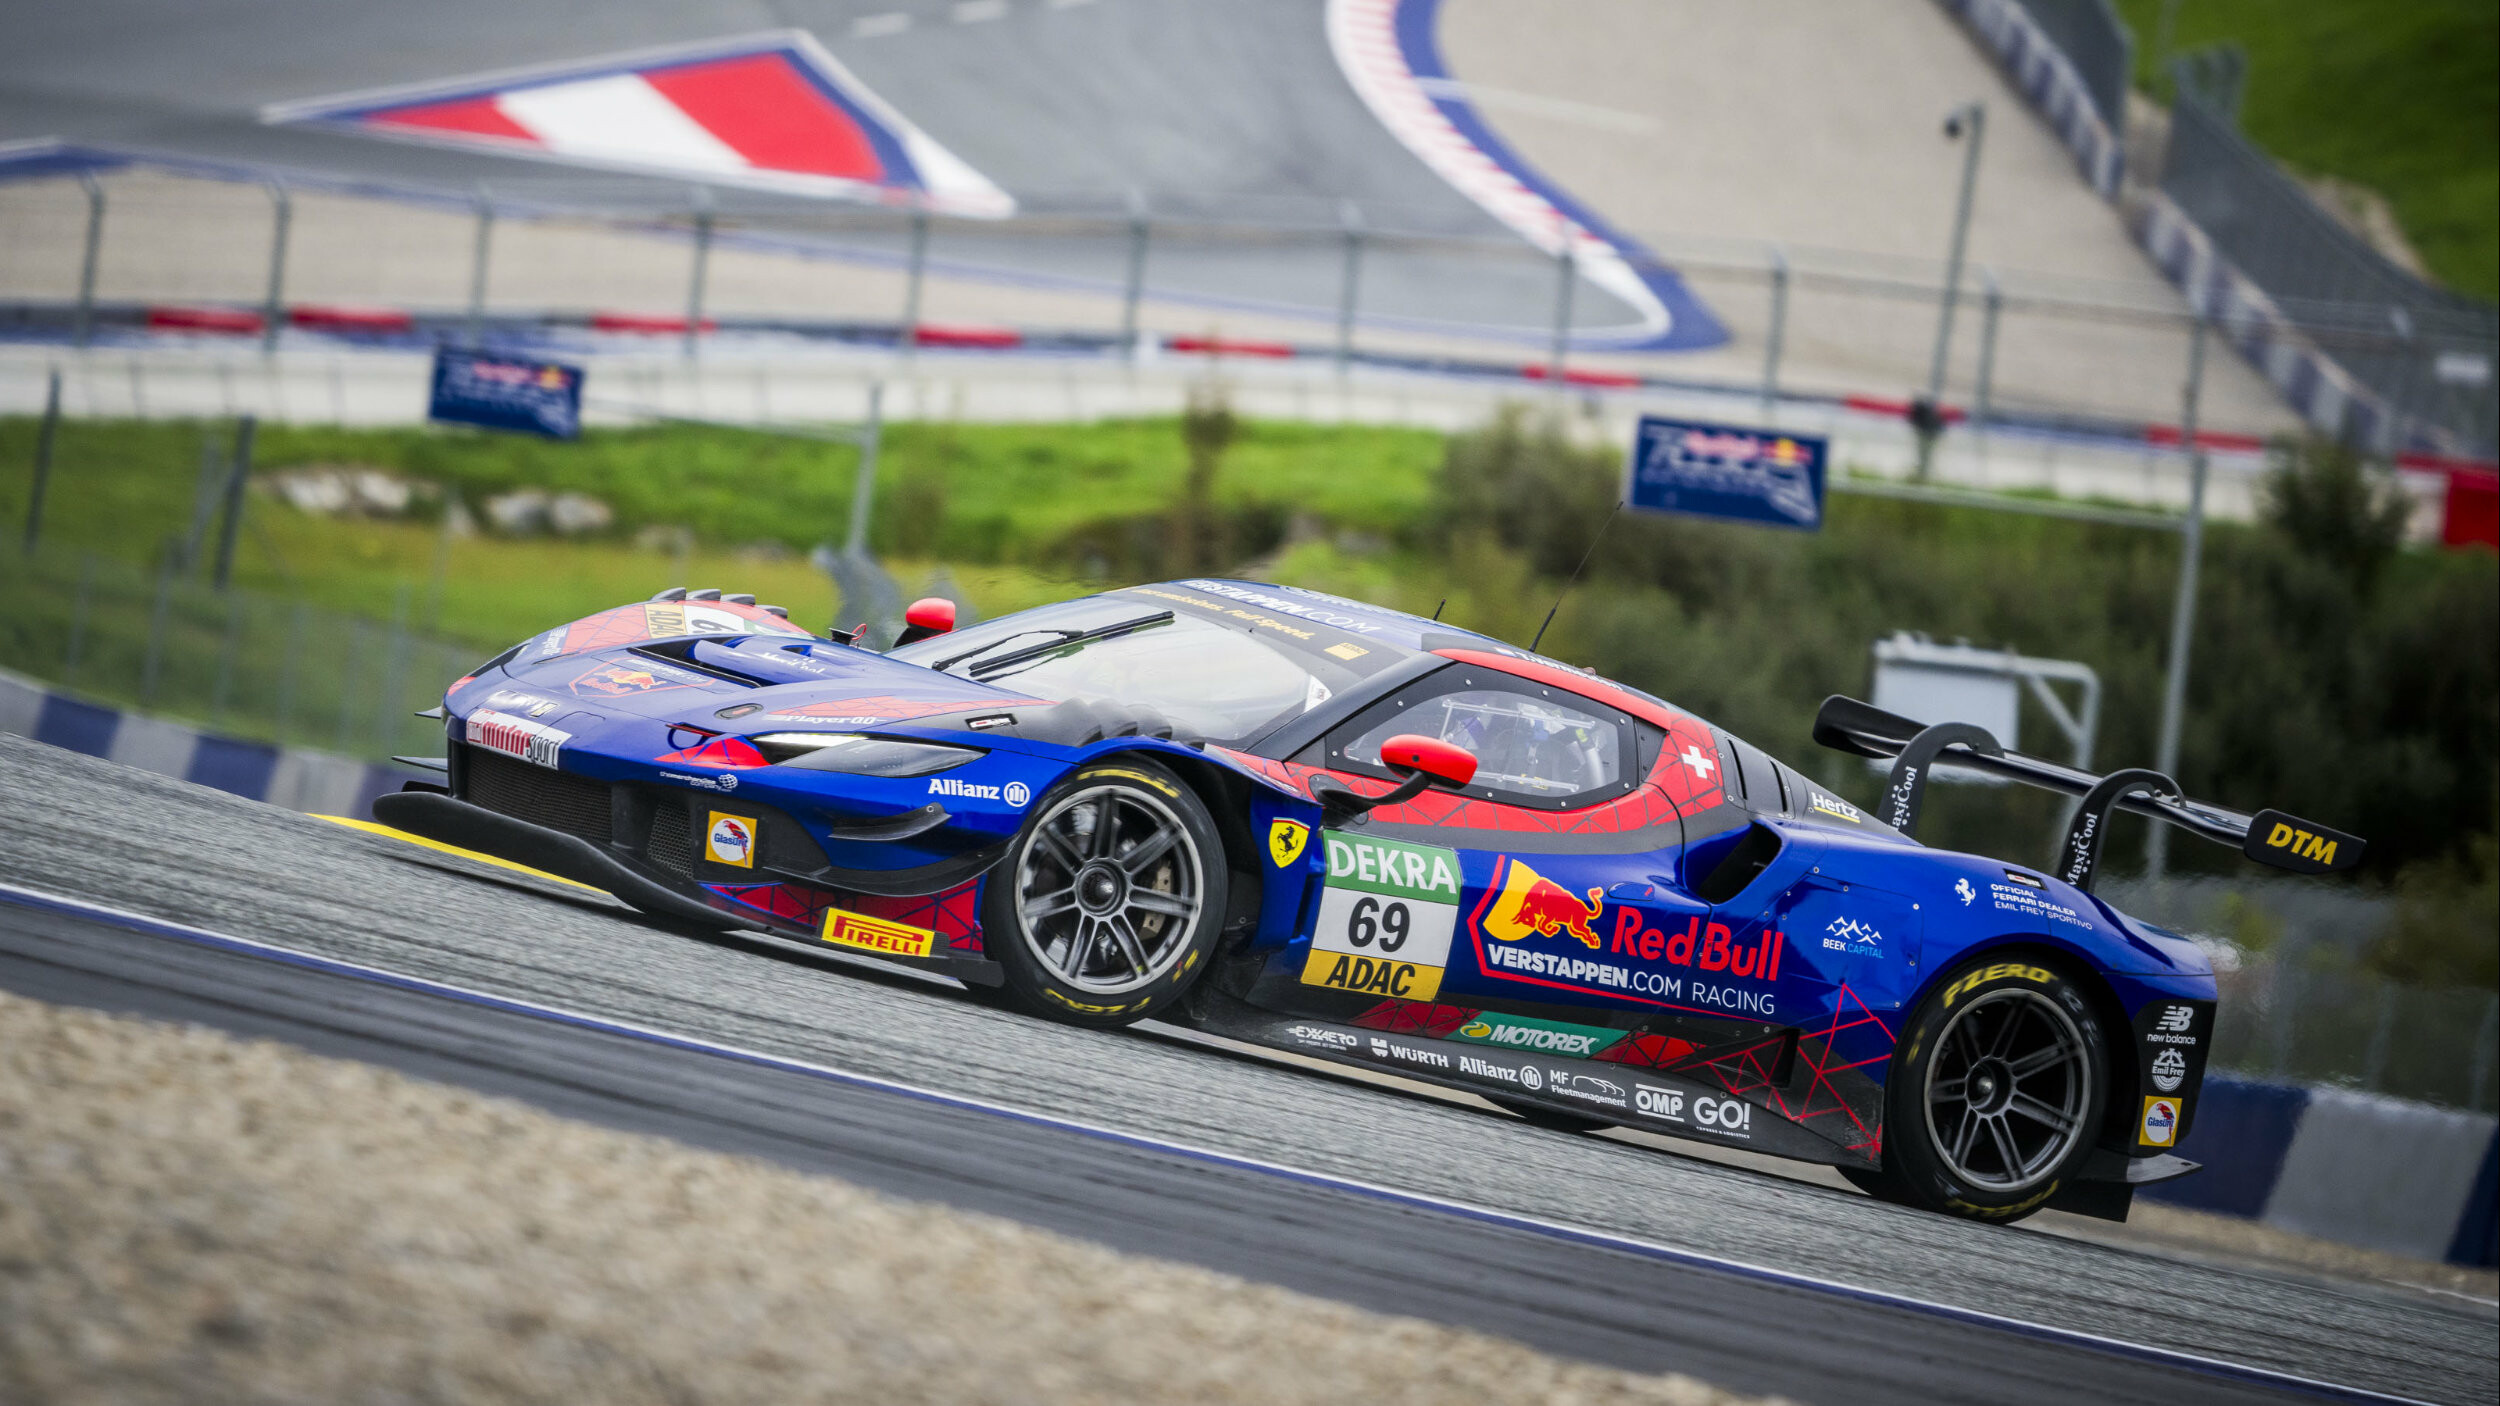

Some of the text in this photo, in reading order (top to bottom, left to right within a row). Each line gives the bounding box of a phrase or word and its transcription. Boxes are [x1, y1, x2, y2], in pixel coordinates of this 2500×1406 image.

[928, 778, 1000, 800] Allianz
[1892, 765, 1918, 827] axiCool
[1811, 791, 1860, 820] Hertz
[2266, 822, 2338, 865] DTM
[1328, 839, 1457, 894] DEKRA
[1990, 883, 2038, 898] OFFICIAL
[1992, 891, 2077, 917] FERRARI DEALER
[1348, 897, 1411, 952] 69
[1995, 901, 2093, 930] EMIL FREY SPORTIVO
[832, 915, 925, 955] PIRELLI
[1611, 905, 1784, 982] Red Bull
[1823, 938, 1884, 959] BEEK CAPITAL
[1325, 955, 1416, 996] ADAC
[1488, 943, 1775, 1014] VERSTAPPEN.COM RACING
[1295, 1025, 1358, 1047] EXXAERO
[1490, 1024, 1597, 1055] MOTOREX
[2147, 1033, 2197, 1045] new balance
[1390, 1044, 1450, 1068] WÜRTH
[1459, 1055, 1519, 1083] Allianz
[1550, 1069, 1569, 1085] MF
[2152, 1065, 2185, 1078] Emil Frey
[1551, 1084, 1627, 1108] Fleetmanagement
[1635, 1090, 1684, 1116] OMP
[1693, 1096, 1751, 1130] GO!
